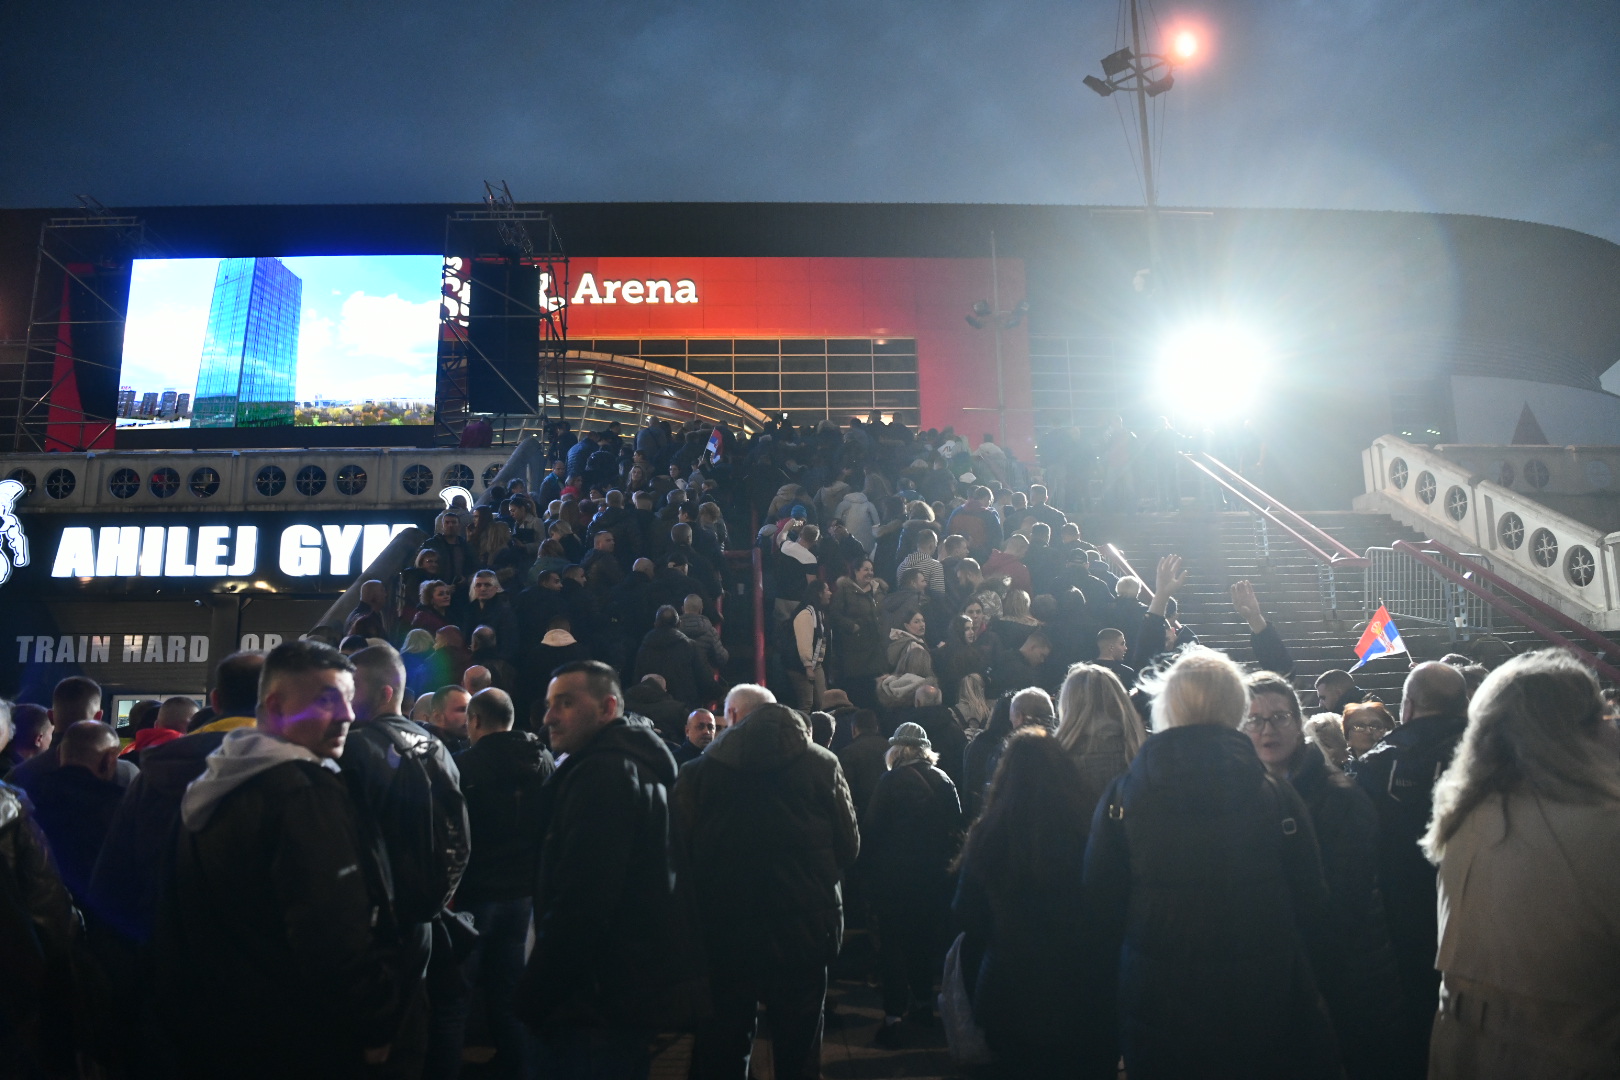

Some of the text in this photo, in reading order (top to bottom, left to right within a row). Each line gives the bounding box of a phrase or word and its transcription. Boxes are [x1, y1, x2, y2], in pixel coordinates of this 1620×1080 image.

[571, 272, 698, 303] Arena
[51, 526, 258, 577] AHILEJ
[17, 635, 110, 662] TRAIN
[123, 635, 209, 663] HARD
